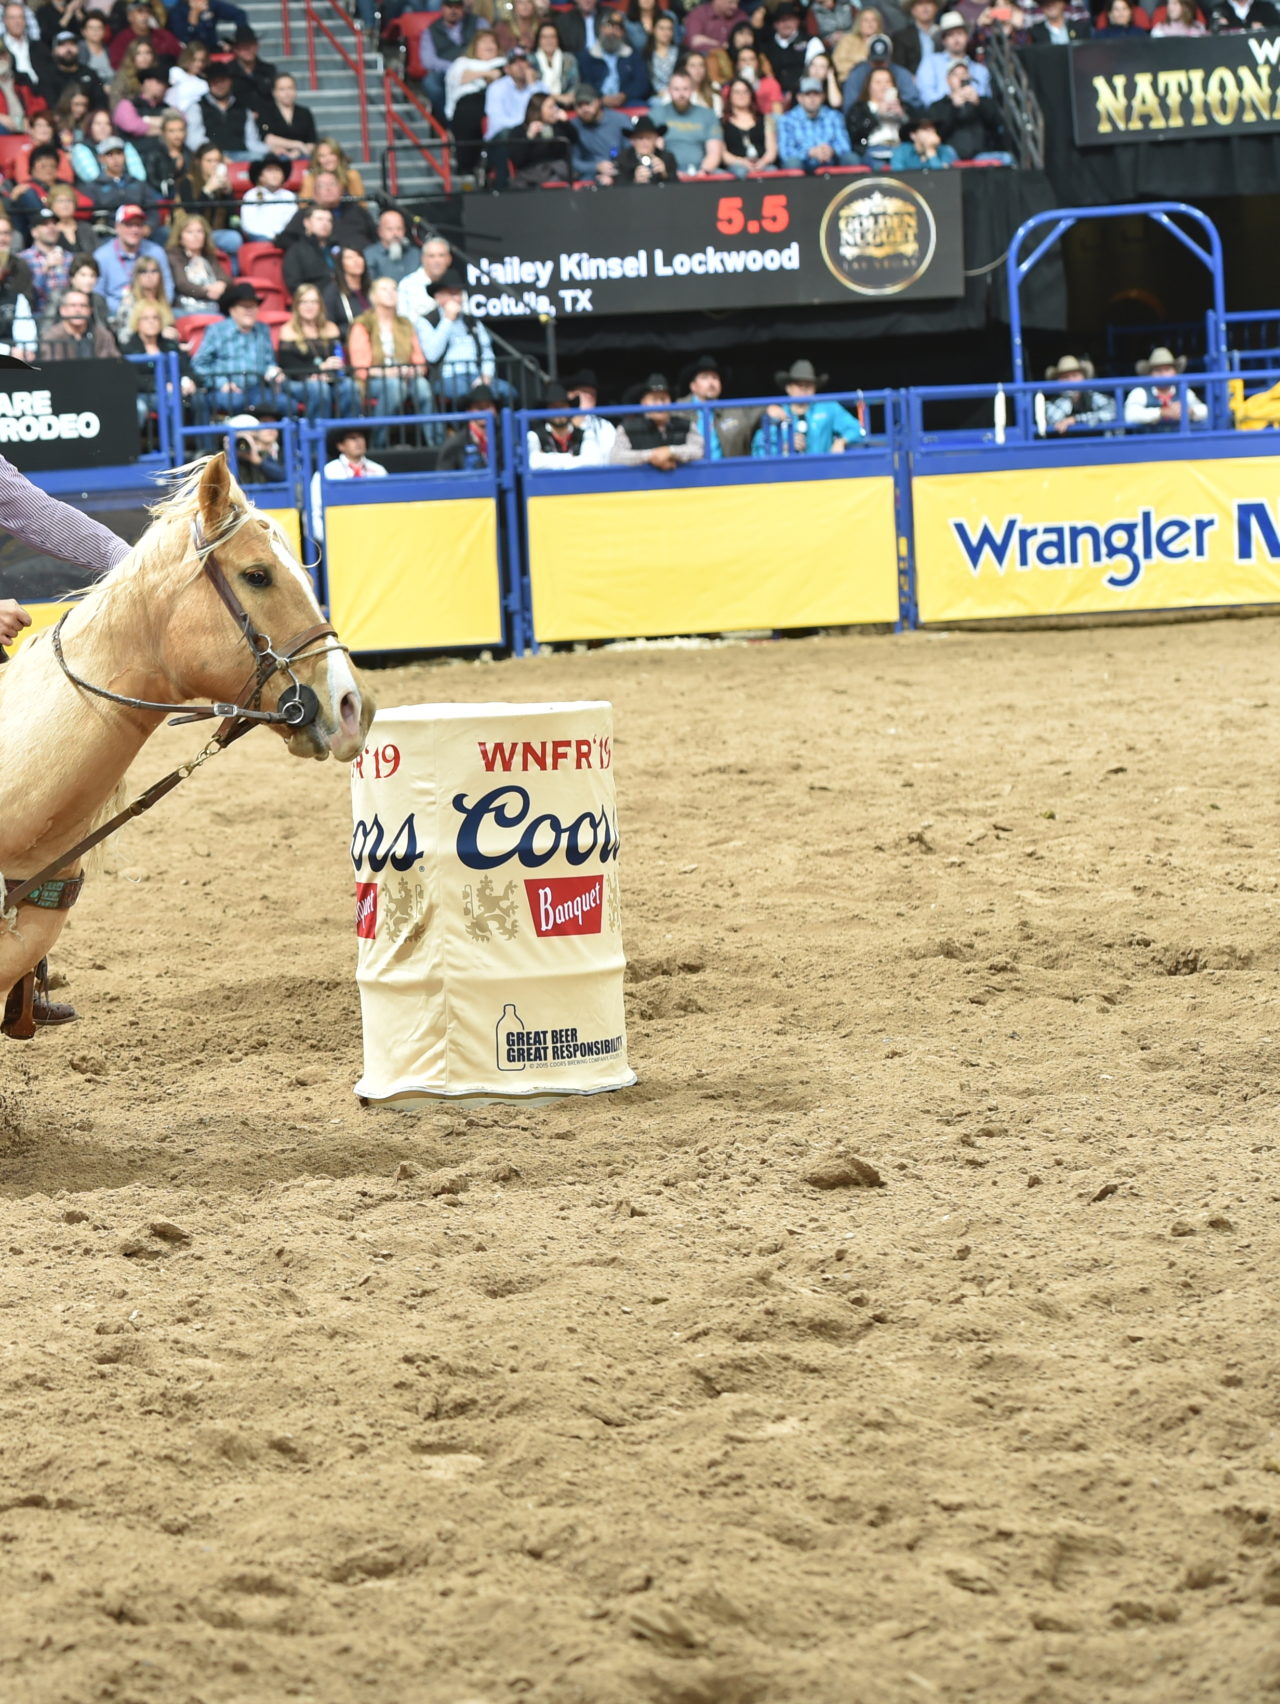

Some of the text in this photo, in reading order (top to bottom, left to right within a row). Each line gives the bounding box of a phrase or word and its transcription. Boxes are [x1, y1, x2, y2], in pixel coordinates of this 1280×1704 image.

[1093, 64, 1280, 133] NATION
[716, 194, 790, 235] 5.5
[466, 242, 800, 288] Hailey Kinsel Lockwood
[558, 288, 593, 313] TX
[951, 509, 1216, 588] Wrangler
[538, 882, 600, 932] Banquet
[506, 1028, 578, 1047] GREAT BEER
[506, 1046, 549, 1063] GREAT
